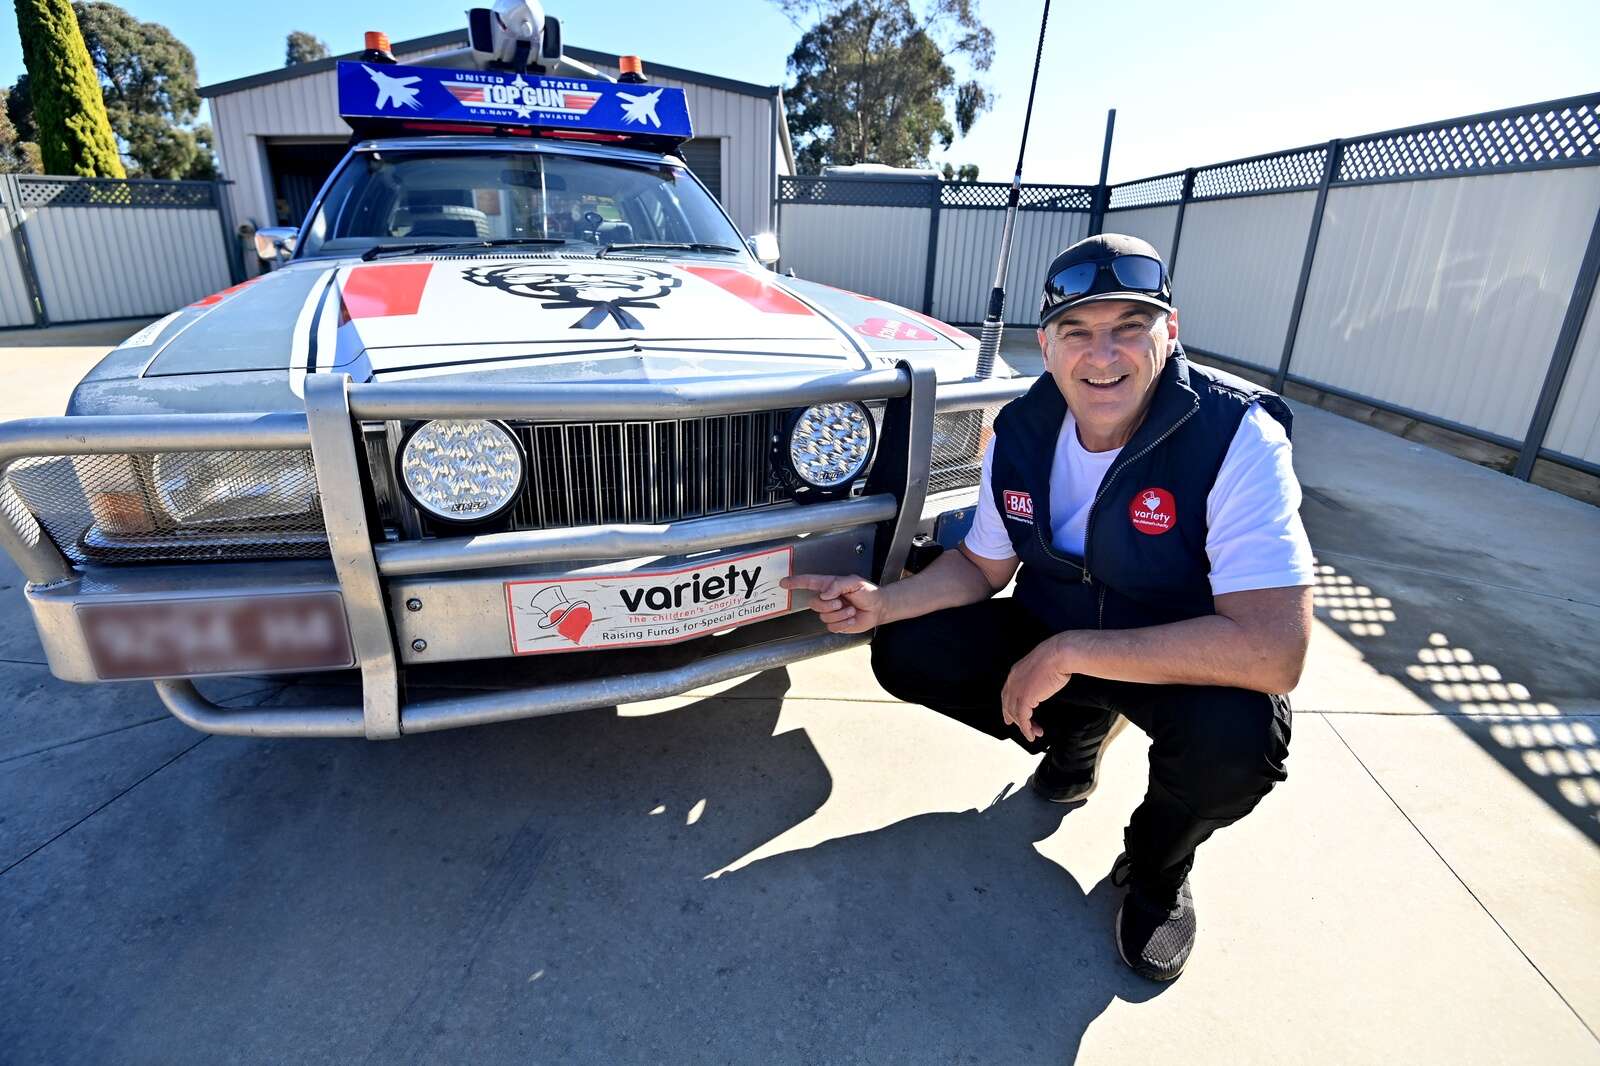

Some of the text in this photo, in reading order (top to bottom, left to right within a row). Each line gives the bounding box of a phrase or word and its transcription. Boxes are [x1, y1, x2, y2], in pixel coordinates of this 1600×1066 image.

[455, 73, 588, 90] UNITED STATES
[483, 84, 565, 108] TOP GUN
[539, 112, 581, 121] AVIATOR
[1010, 495, 1034, 514] BAS
[1134, 510, 1170, 524] variety
[620, 565, 761, 612] variety
[602, 601, 776, 640] Raising Funds for Special Children
[628, 615, 646, 624] the
[652, 606, 704, 622] children's
